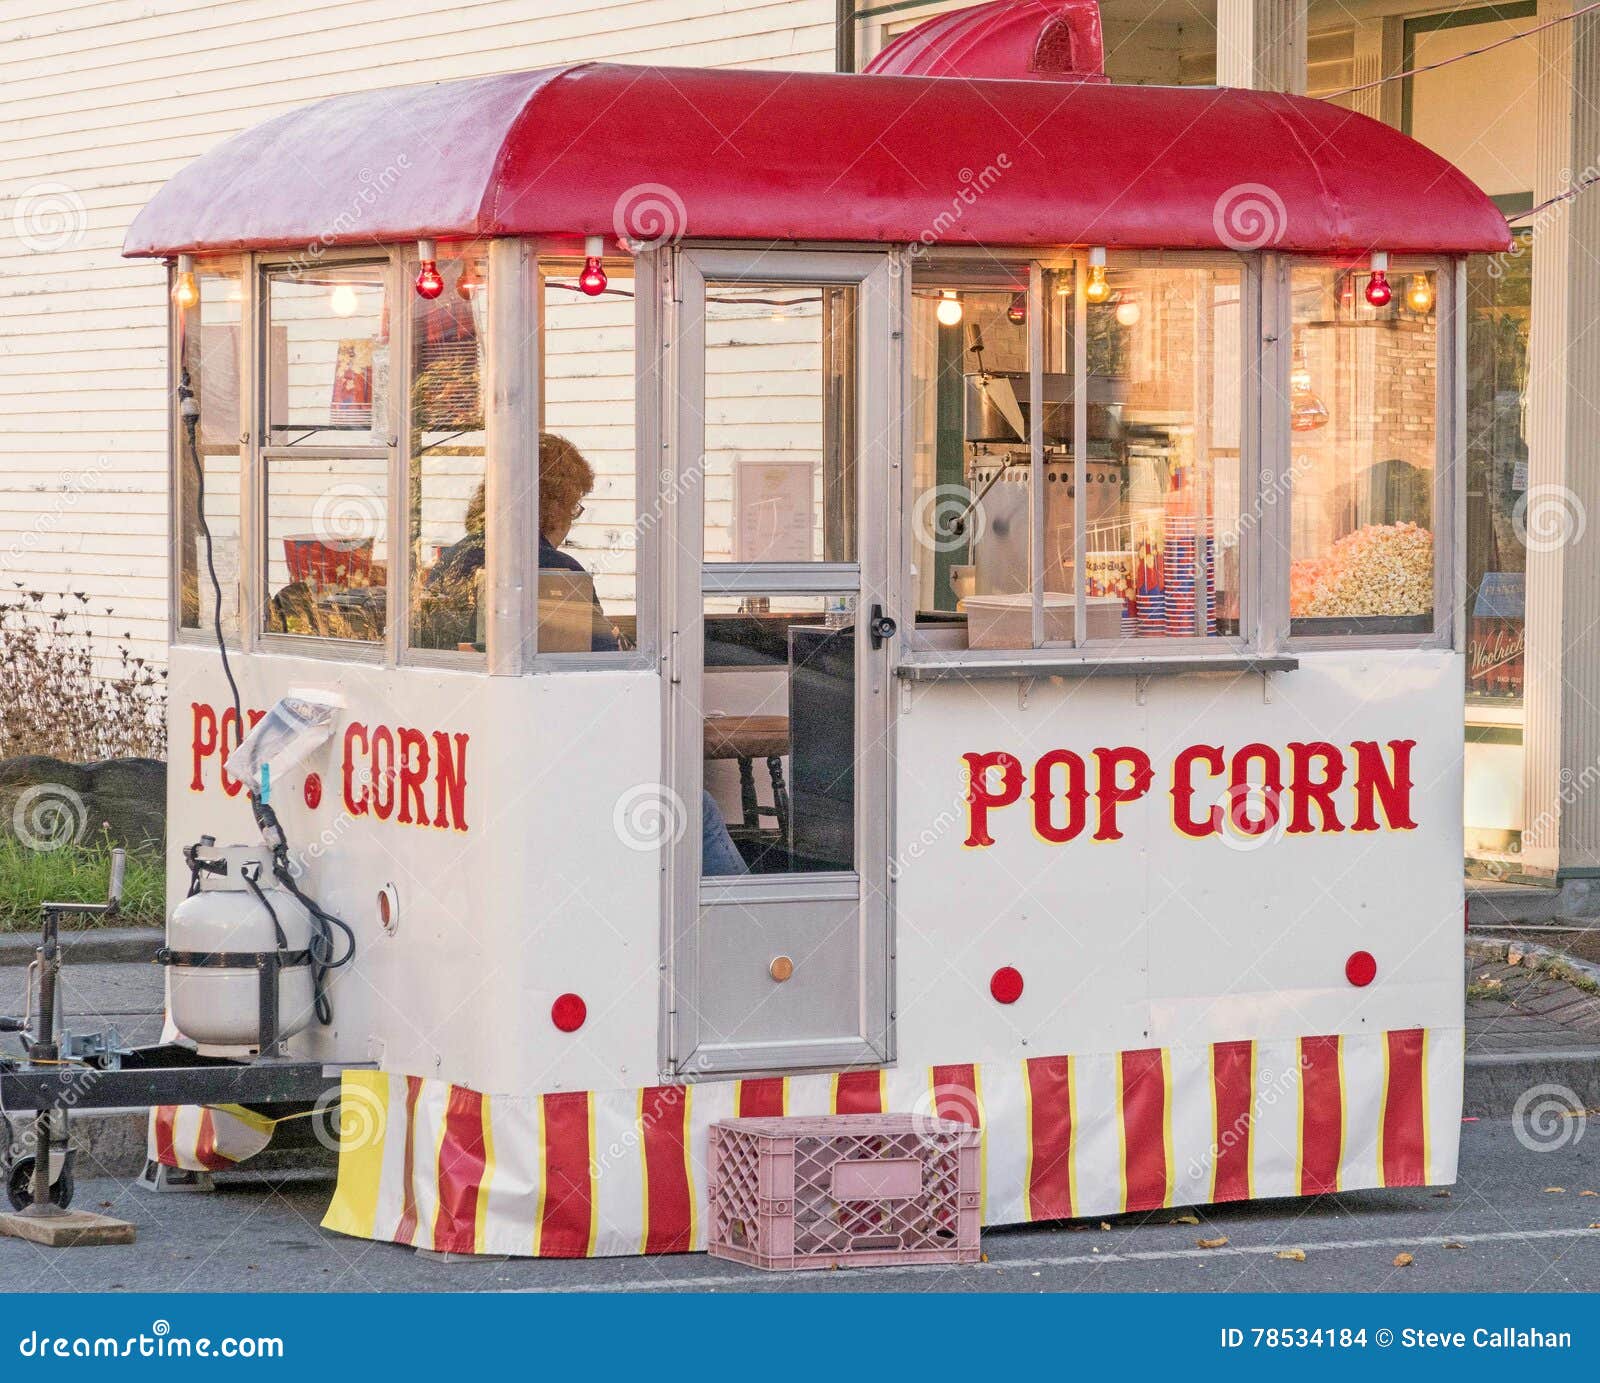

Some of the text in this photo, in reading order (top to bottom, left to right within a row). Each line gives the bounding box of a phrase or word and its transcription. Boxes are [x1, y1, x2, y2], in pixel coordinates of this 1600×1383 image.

[1469, 627, 1526, 671] Woolrich
[190, 702, 470, 832] PO CORN
[959, 739, 1419, 849] POP CORN
